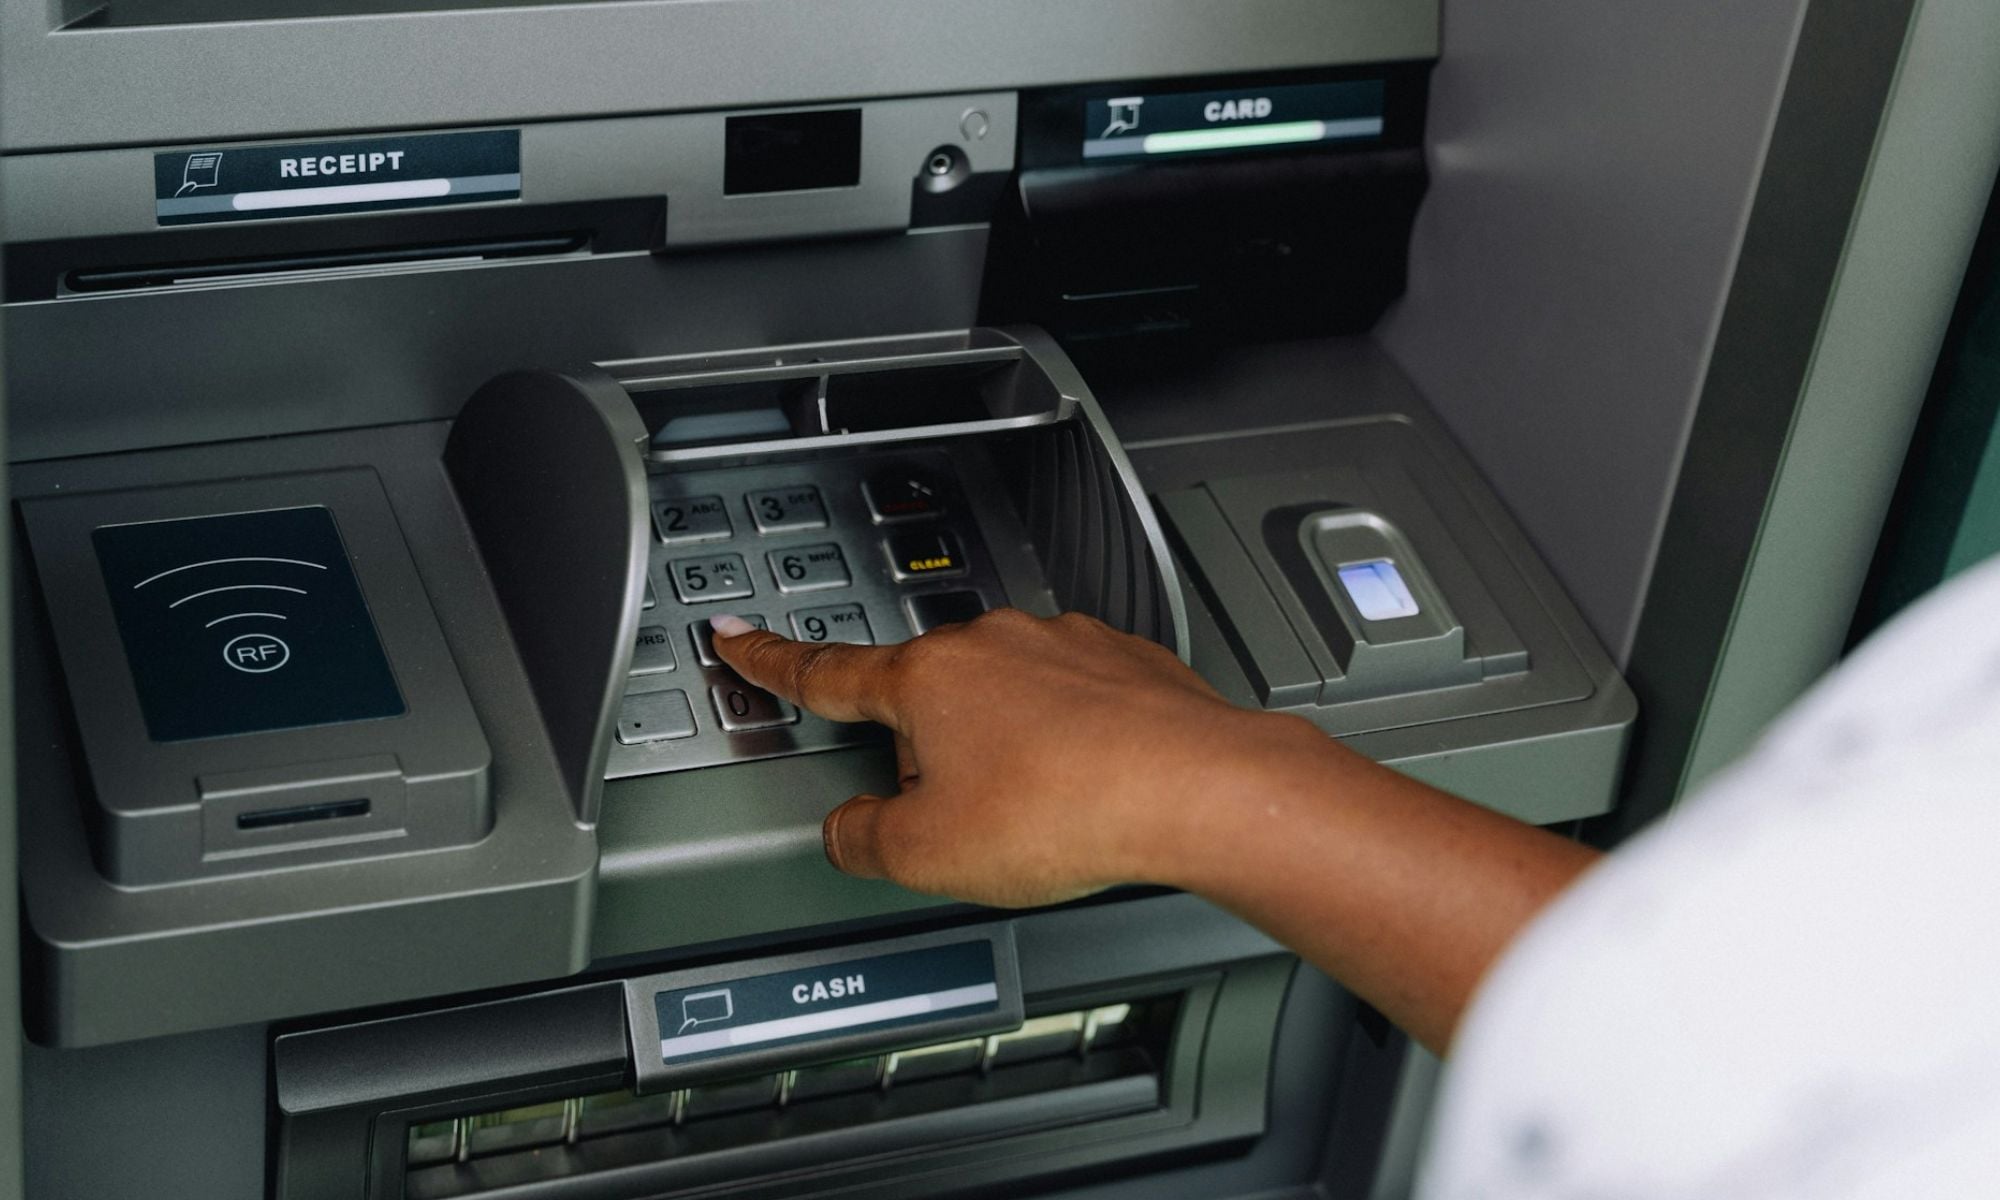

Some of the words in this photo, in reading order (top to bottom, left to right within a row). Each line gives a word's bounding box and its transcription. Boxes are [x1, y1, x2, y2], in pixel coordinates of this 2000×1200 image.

[1204, 97, 1273, 122] CARD
[280, 151, 404, 178] RECEIPT
[663, 507, 688, 532] 2
[691, 503, 721, 514] ABC
[761, 497, 784, 521] 3
[685, 566, 708, 591] 5
[712, 562, 738, 573] JKL
[782, 556, 806, 580] 6
[909, 557, 952, 571] CLEAR
[804, 616, 827, 641] 9
[236, 644, 277, 663] RF
[728, 690, 749, 716] 0
[792, 974, 865, 1004] CASH
